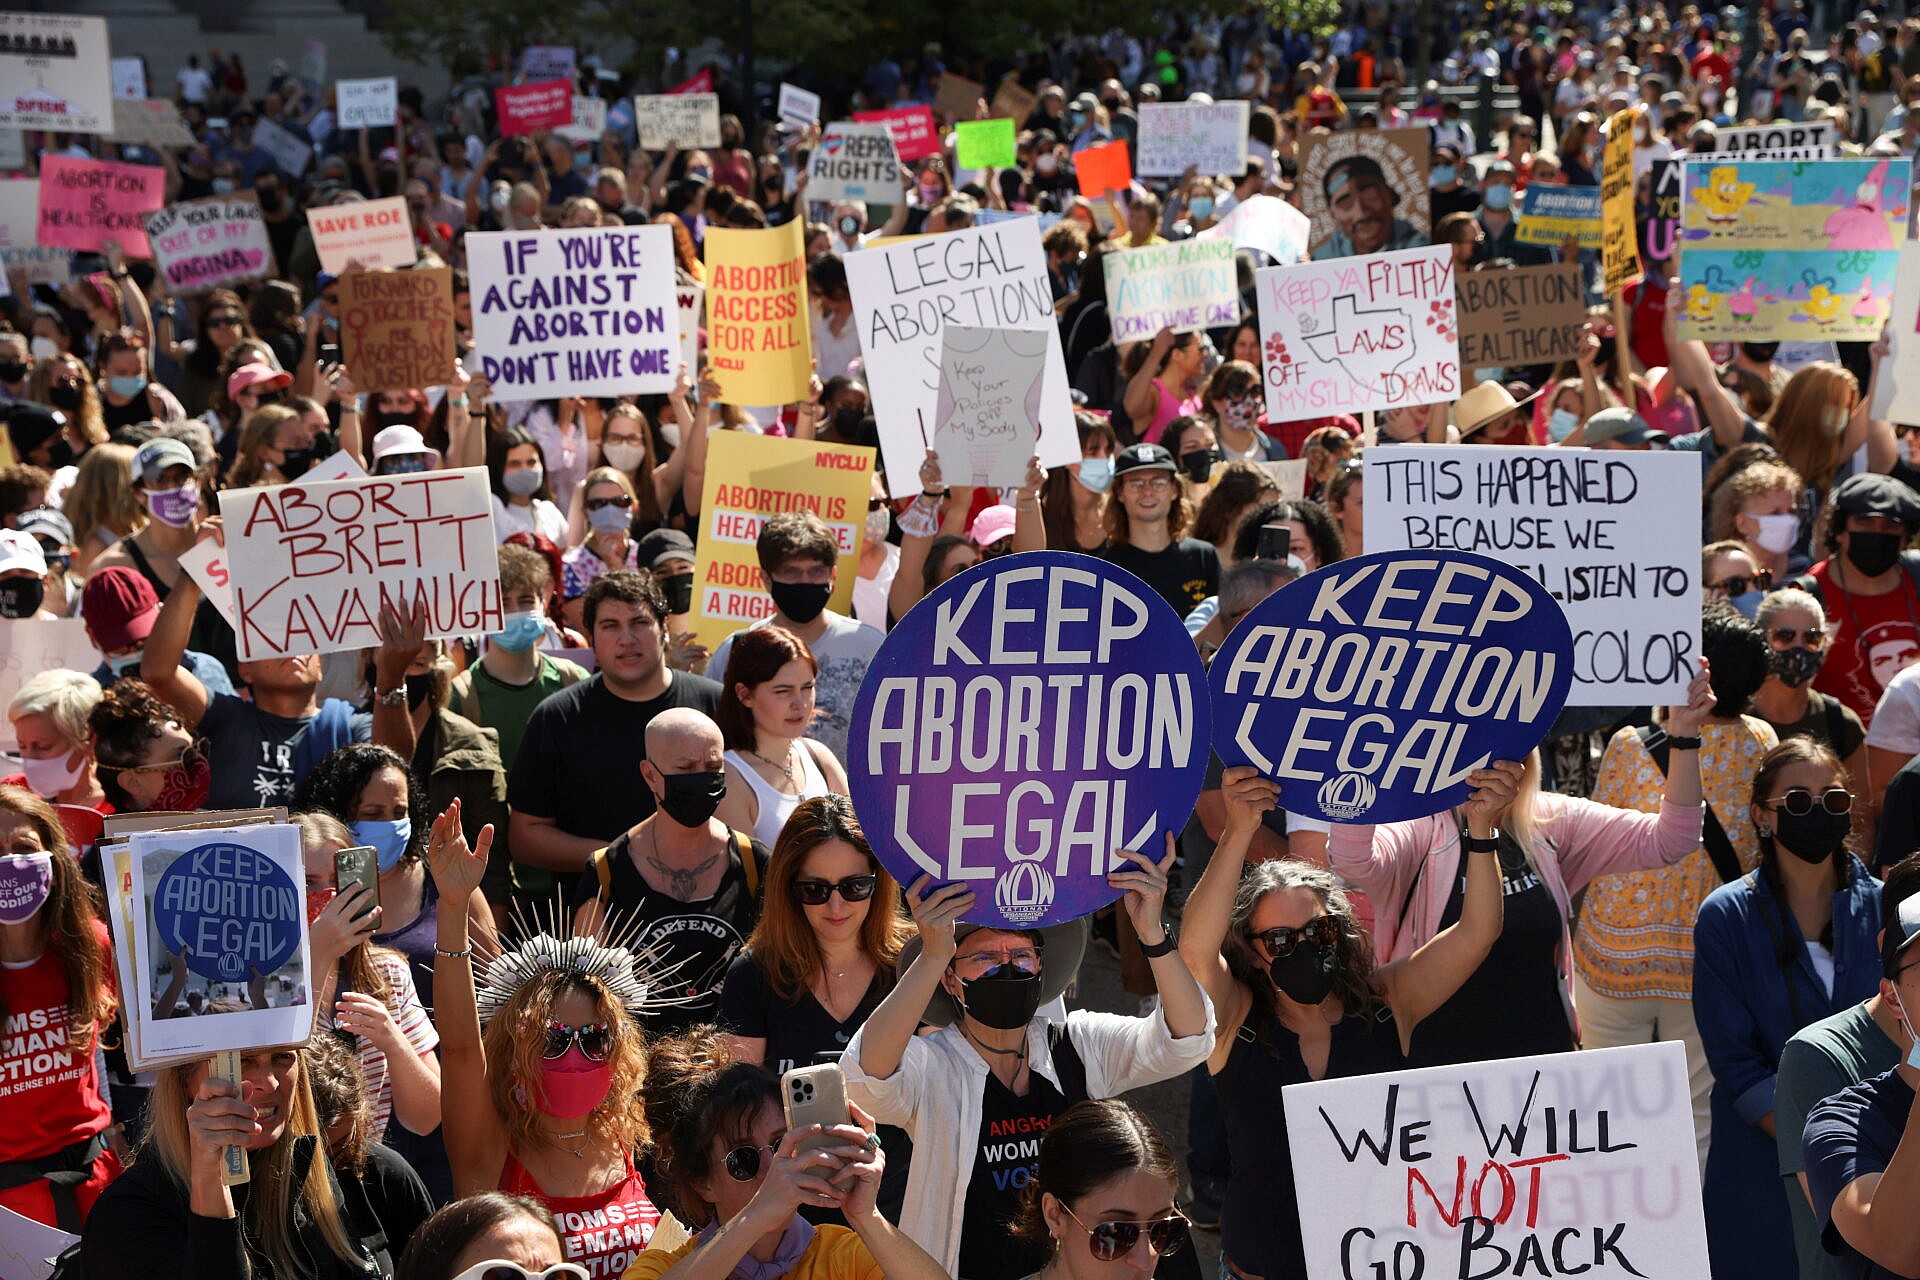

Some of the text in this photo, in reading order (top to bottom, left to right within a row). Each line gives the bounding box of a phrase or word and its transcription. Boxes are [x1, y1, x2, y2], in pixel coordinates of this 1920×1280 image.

[1725, 127, 1825, 151] ABORT
[54, 167, 146, 193] ABORTION
[814, 157, 898, 184] RIGHTS
[90, 193, 107, 211] IS
[183, 205, 220, 226] YOUR
[315, 208, 401, 235] SAVE ROE
[167, 247, 250, 284] VAGINA
[502, 233, 642, 276] IF YOU'RE
[884, 231, 1025, 295] LEGAL
[351, 275, 438, 299] FORWARD
[481, 273, 638, 314] AGAINST
[1116, 265, 1229, 312] ABORTION
[1333, 266, 1367, 295] YA
[1454, 272, 1580, 314] ABORTION
[509, 306, 666, 346] ABORTION
[712, 291, 798, 323] ACCESS
[870, 275, 1054, 349] ABORTIONS
[712, 322, 801, 351] FOR ALL.
[1335, 323, 1406, 356] LAWS
[481, 347, 671, 386] DON'T HAVE ONE
[712, 355, 745, 371] ACLU
[1267, 360, 1309, 388] OFF
[1276, 388, 1309, 412] MY
[1380, 361, 1458, 405] DRAWS
[815, 450, 868, 472] NYCLU
[714, 482, 847, 520] ABORTION IS
[1371, 456, 1638, 508] THIS HAPPENED
[243, 474, 465, 538] ABORT
[278, 513, 489, 579] BRETT
[1403, 514, 1618, 552] BECAUSE WE
[706, 591, 722, 614] A
[1307, 559, 1534, 639] KEEP
[1538, 562, 1690, 605] LISTEN TO
[238, 572, 505, 659] KAVANAUGH
[932, 565, 1150, 666] KEEP
[1224, 624, 1557, 724] ABORTION
[1572, 630, 1696, 685] COLOR
[867, 673, 1195, 777] ABORTION
[1234, 702, 1493, 795] LEGAL
[1317, 773, 1377, 810] NOW
[894, 779, 1158, 882] LEGAL
[191, 846, 275, 883] KEEP
[995, 862, 1056, 907] NOW
[13, 881, 38, 897] OUR
[163, 874, 298, 923] ABORTION
[172, 913, 288, 962] LEGAL
[650, 919, 728, 941] DEFEND
[13, 1076, 45, 1095] SENSE
[45, 1075, 56, 1086] IN
[1317, 1069, 1639, 1167] WE WILL
[1406, 1153, 1573, 1230] NOT
[1340, 1214, 1650, 1280] GO BACK
